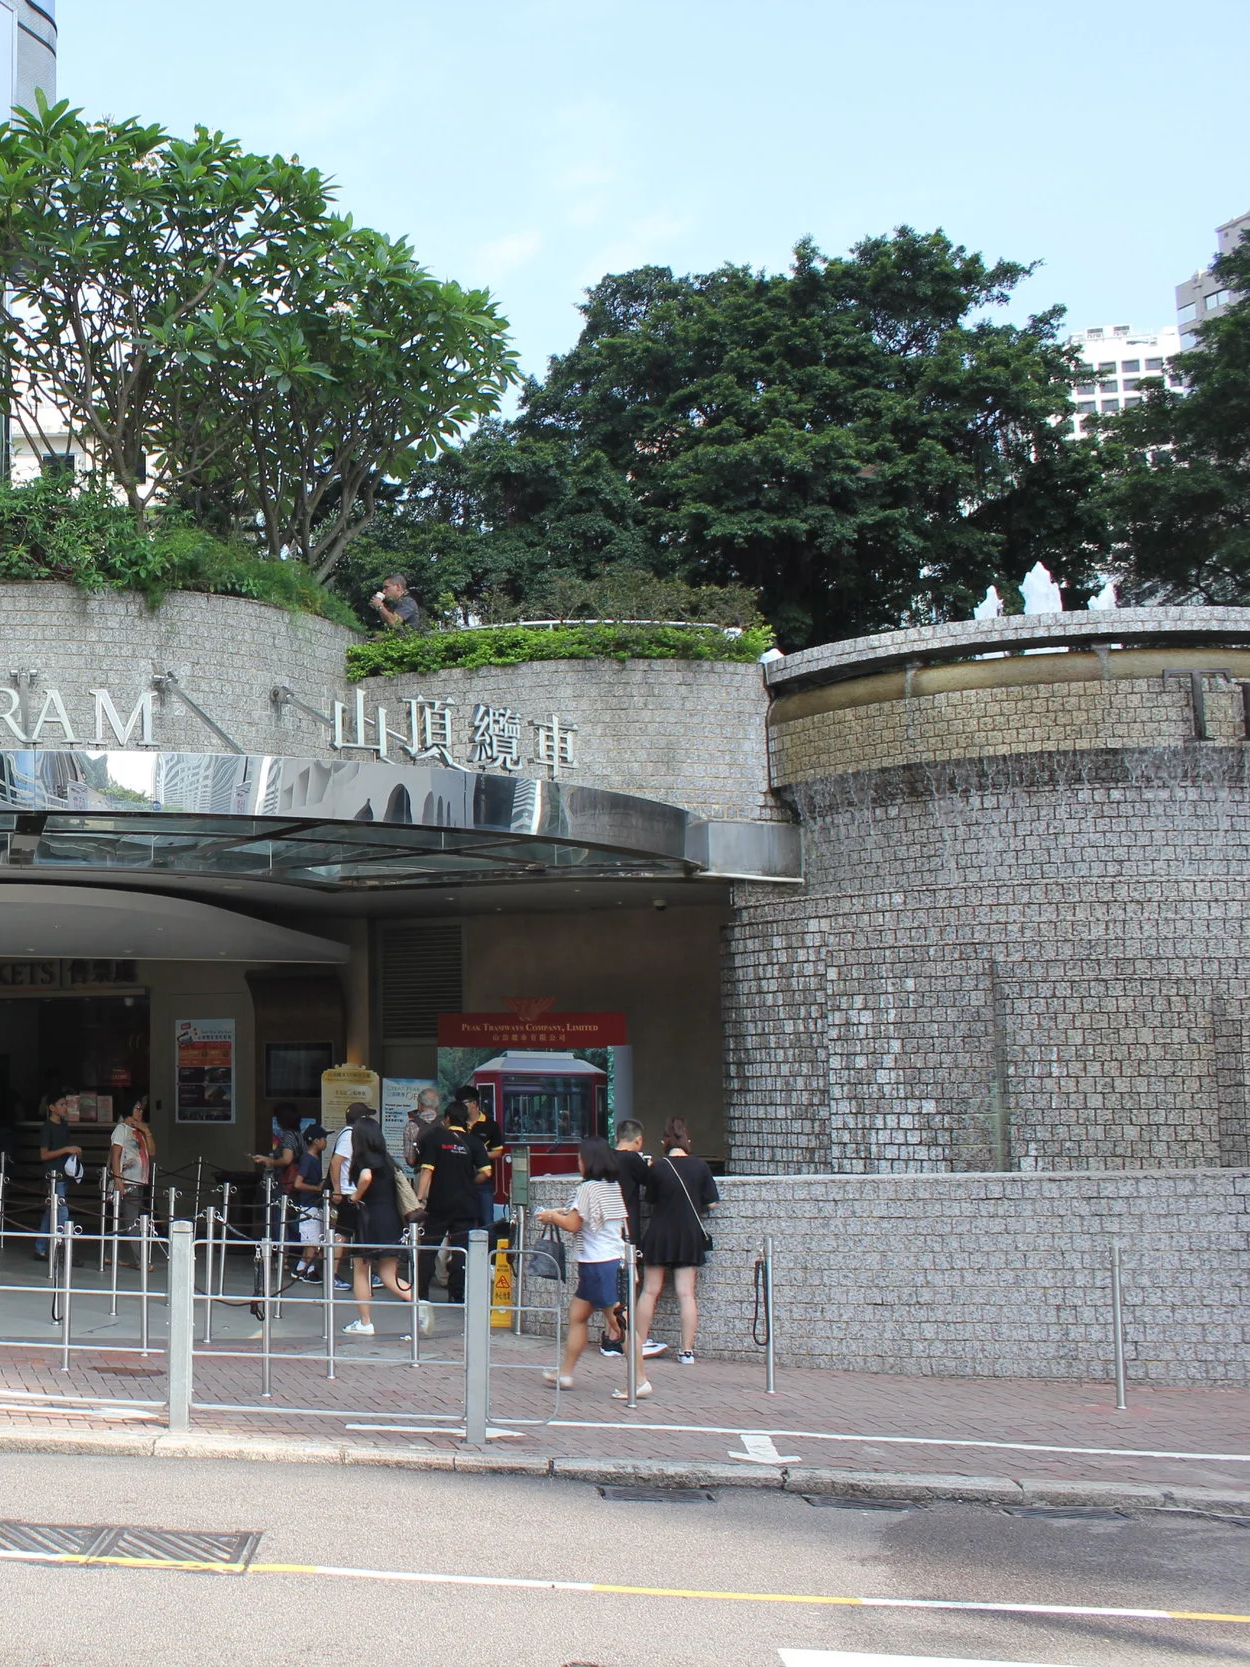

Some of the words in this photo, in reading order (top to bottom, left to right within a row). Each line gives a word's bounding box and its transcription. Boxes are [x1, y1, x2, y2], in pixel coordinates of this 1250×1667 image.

[330, 688, 578, 779] 山頂纜車
[461, 1023, 482, 1031] PEAK
[483, 1023, 524, 1031] TRAMWAYS
[525, 1023, 565, 1033] COMPANY,
[566, 1023, 599, 1031] LIMITED
